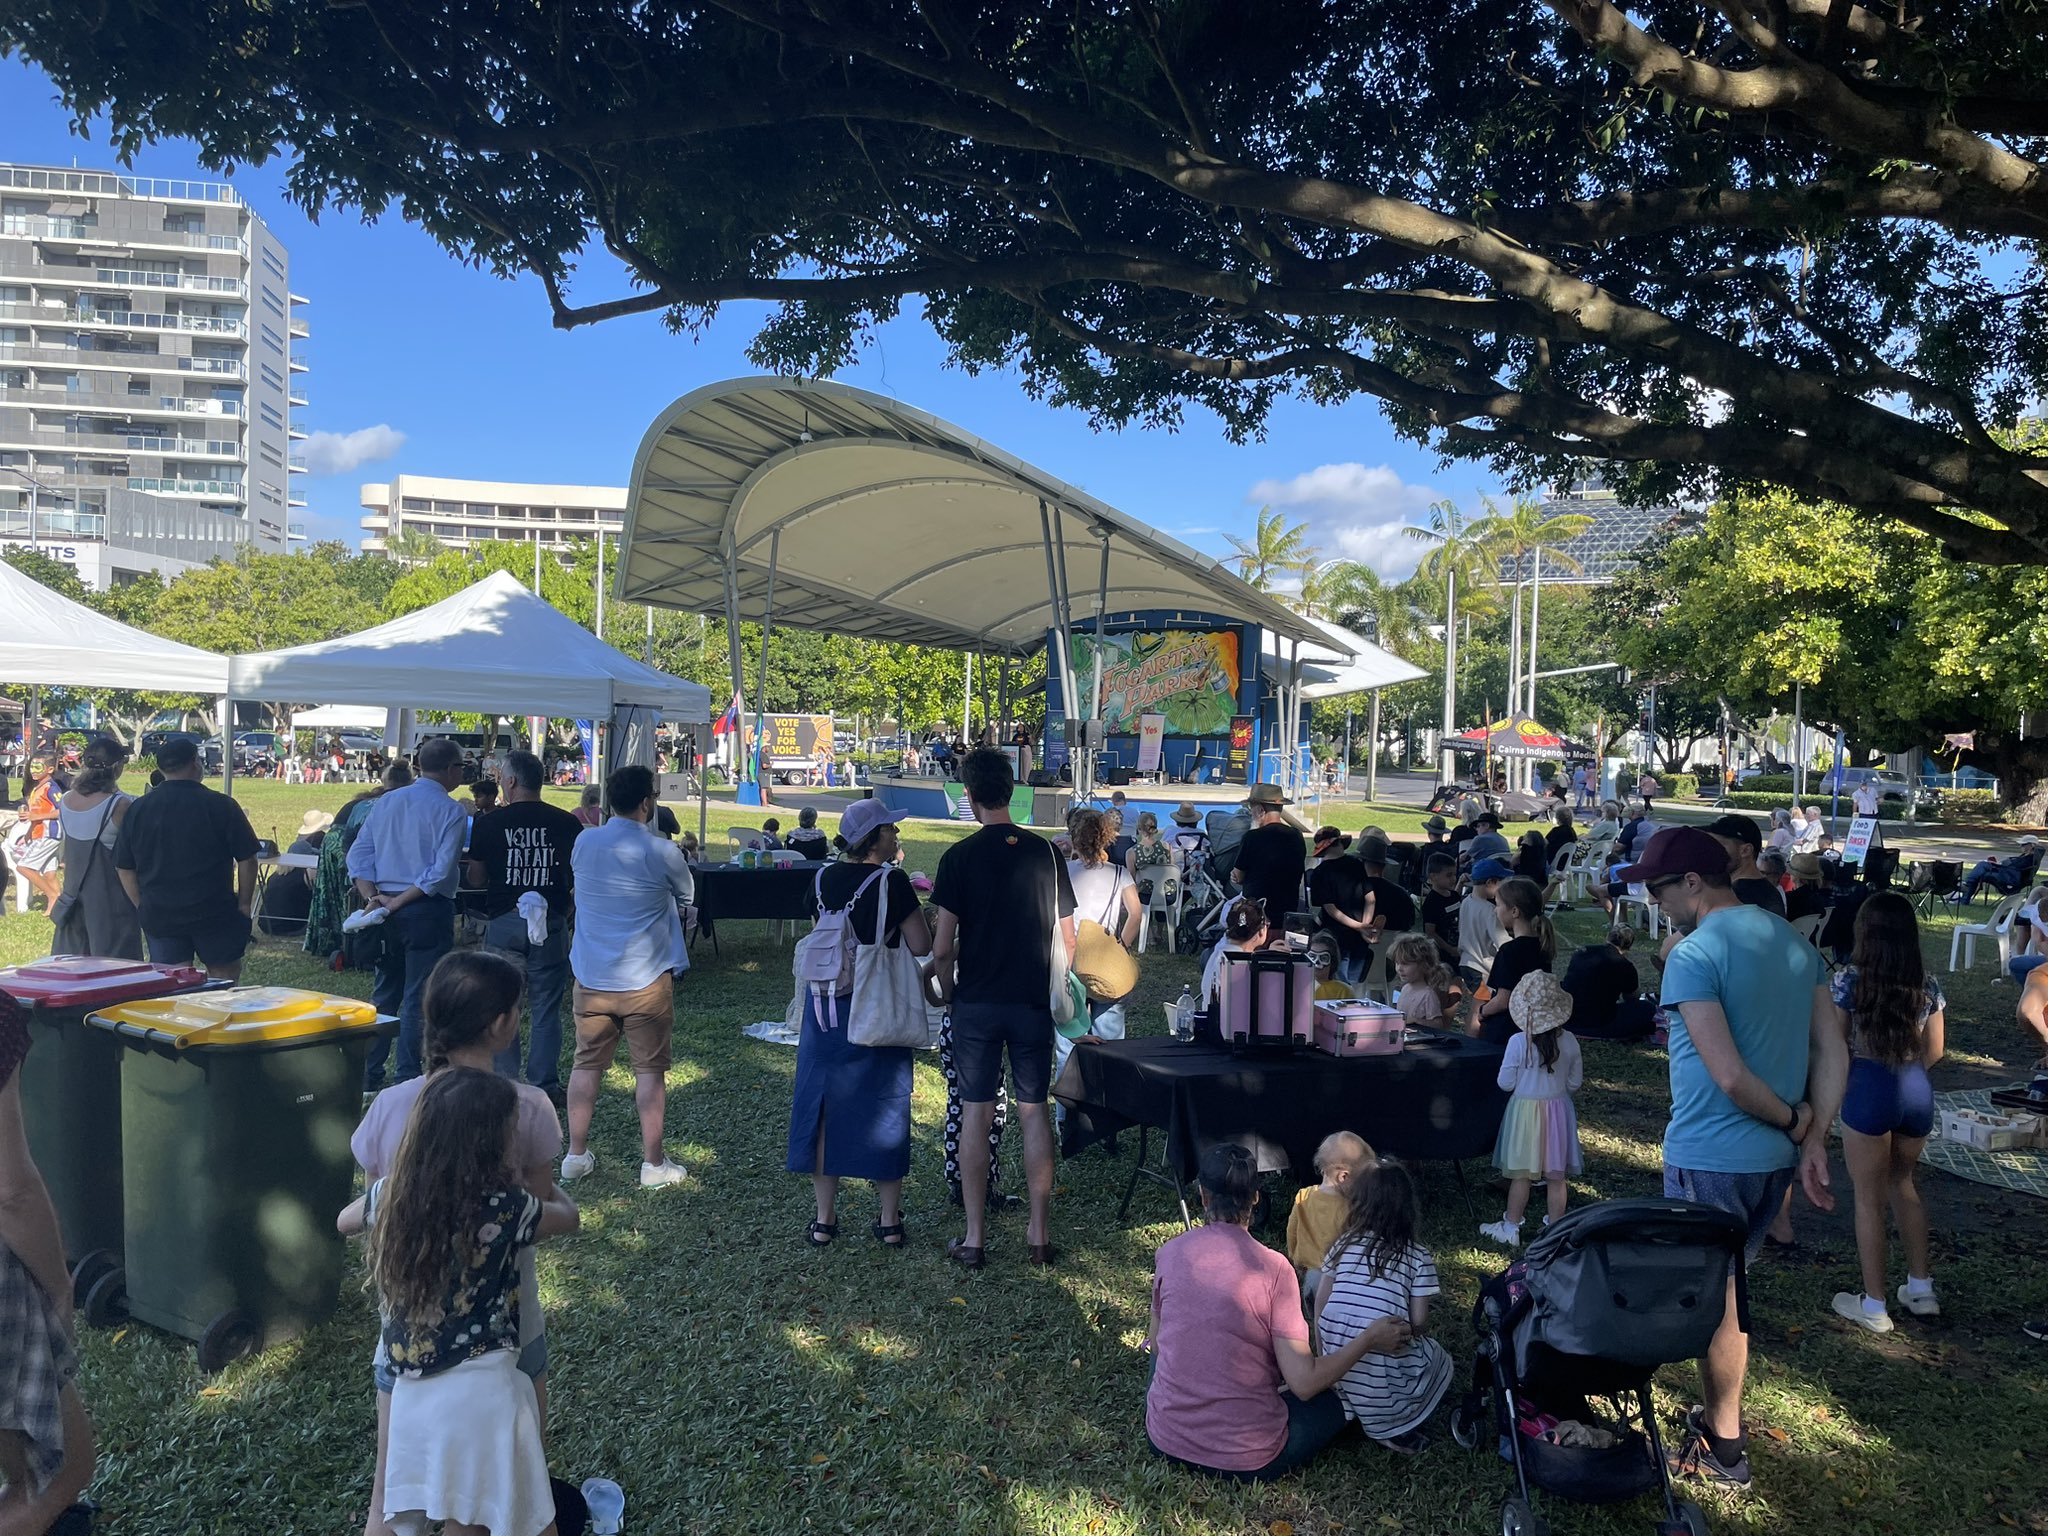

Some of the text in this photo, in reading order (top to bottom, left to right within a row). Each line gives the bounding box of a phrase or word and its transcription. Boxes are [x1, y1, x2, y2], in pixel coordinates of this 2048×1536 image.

[1101, 639, 1208, 706] FOGARTY
[1120, 669, 1200, 720] PARK
[774, 718, 800, 727] VOTE
[777, 727, 796, 736] YES
[1144, 726, 1158, 735] Yes
[776, 736, 796, 745] FOR
[772, 745, 801, 755] VOICE
[1498, 744, 1596, 760] Cairns Indigenous Media
[507, 847, 560, 868] TREATY.
[505, 867, 554, 887] TRUTH.
